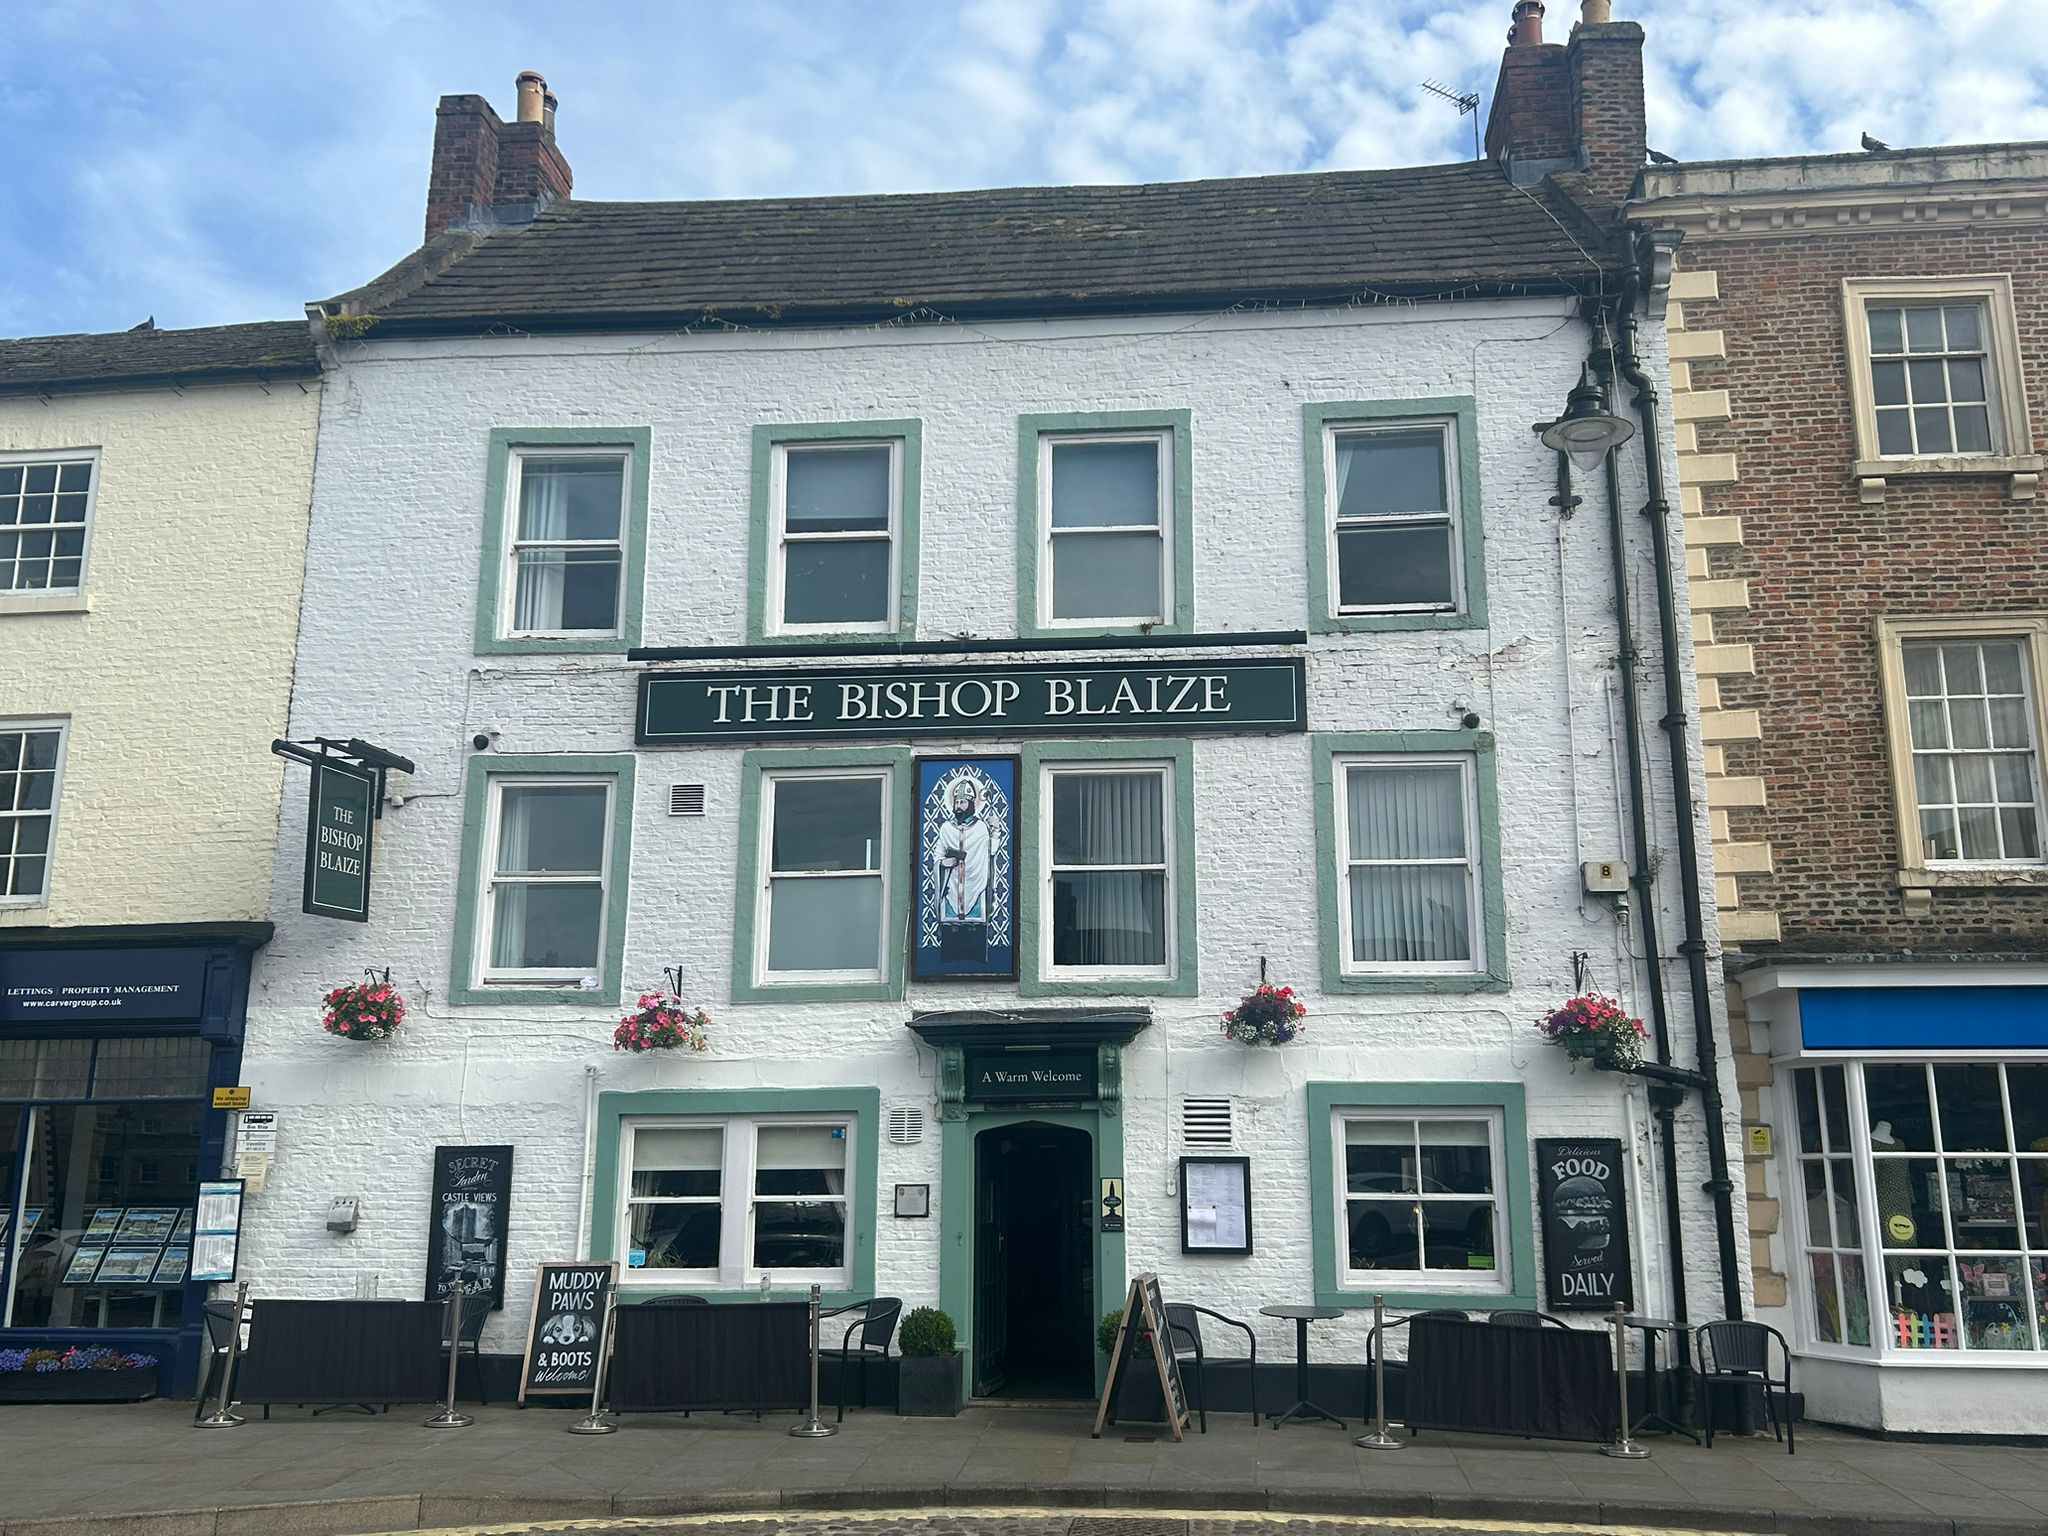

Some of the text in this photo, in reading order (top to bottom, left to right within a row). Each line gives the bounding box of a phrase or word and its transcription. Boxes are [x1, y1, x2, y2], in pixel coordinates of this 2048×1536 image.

[707, 675, 1232, 723] THE BISHOP BLAIZE
[333, 806, 353, 825] THE
[321, 825, 363, 851] BISHOP
[320, 851, 361, 876] BLAIZE
[1602, 865, 1610, 876] 8
[7, 984, 180, 996] LETTINGS PROPERTY MANAGEMENT
[22, 998, 122, 1008] www.carvergroup.co.uk
[982, 1069, 1082, 1082] A Warm Welcome
[1557, 1145, 1601, 1157] Delicious
[448, 1156, 499, 1173] SECRET
[1551, 1158, 1610, 1181] FOOD
[449, 1170, 488, 1187] Garden
[442, 1192, 497, 1202] CASTLE VIEWS
[1571, 1251, 1604, 1267] Served
[437, 1284, 447, 1292] TO
[463, 1277, 493, 1295] EAR
[549, 1271, 605, 1290] MUDDY
[1562, 1272, 1615, 1296] DAILY
[551, 1291, 595, 1311] PAWS
[537, 1351, 592, 1367] & BOOTS
